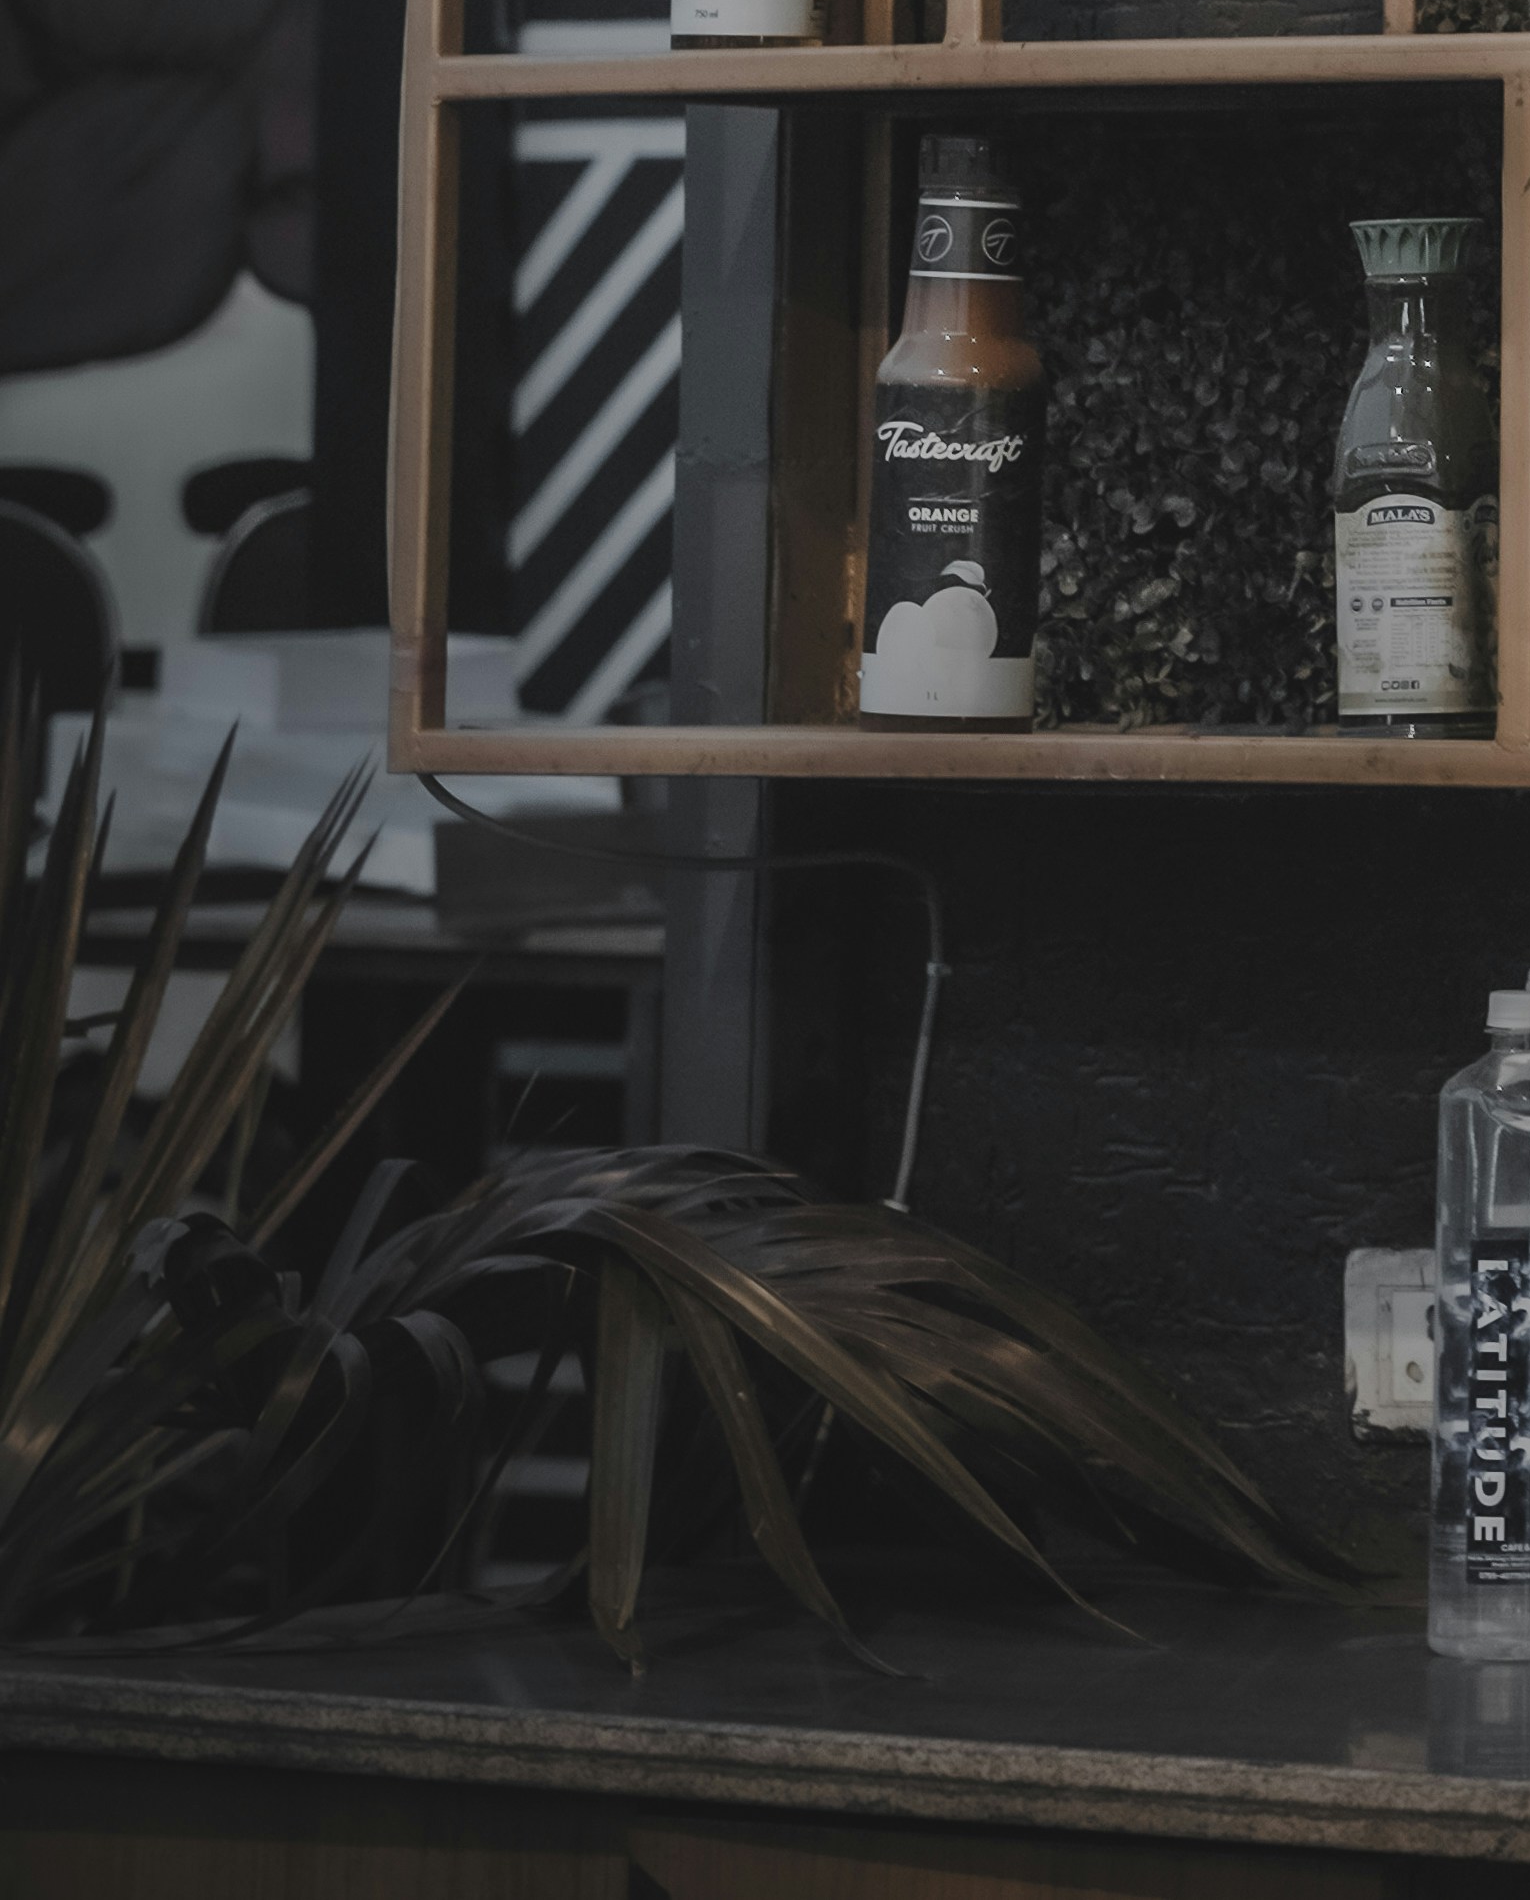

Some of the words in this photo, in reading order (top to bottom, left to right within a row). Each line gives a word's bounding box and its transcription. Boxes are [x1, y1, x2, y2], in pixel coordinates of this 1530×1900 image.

[878, 420, 1024, 473] Tastecraft
[908, 506, 979, 523] ORANGE
[1370, 508, 1431, 523] MALA'S
[911, 522, 937, 533] FRUIT
[940, 523, 974, 534] CRUSH
[1473, 1258, 1510, 1543] LATITUDE
